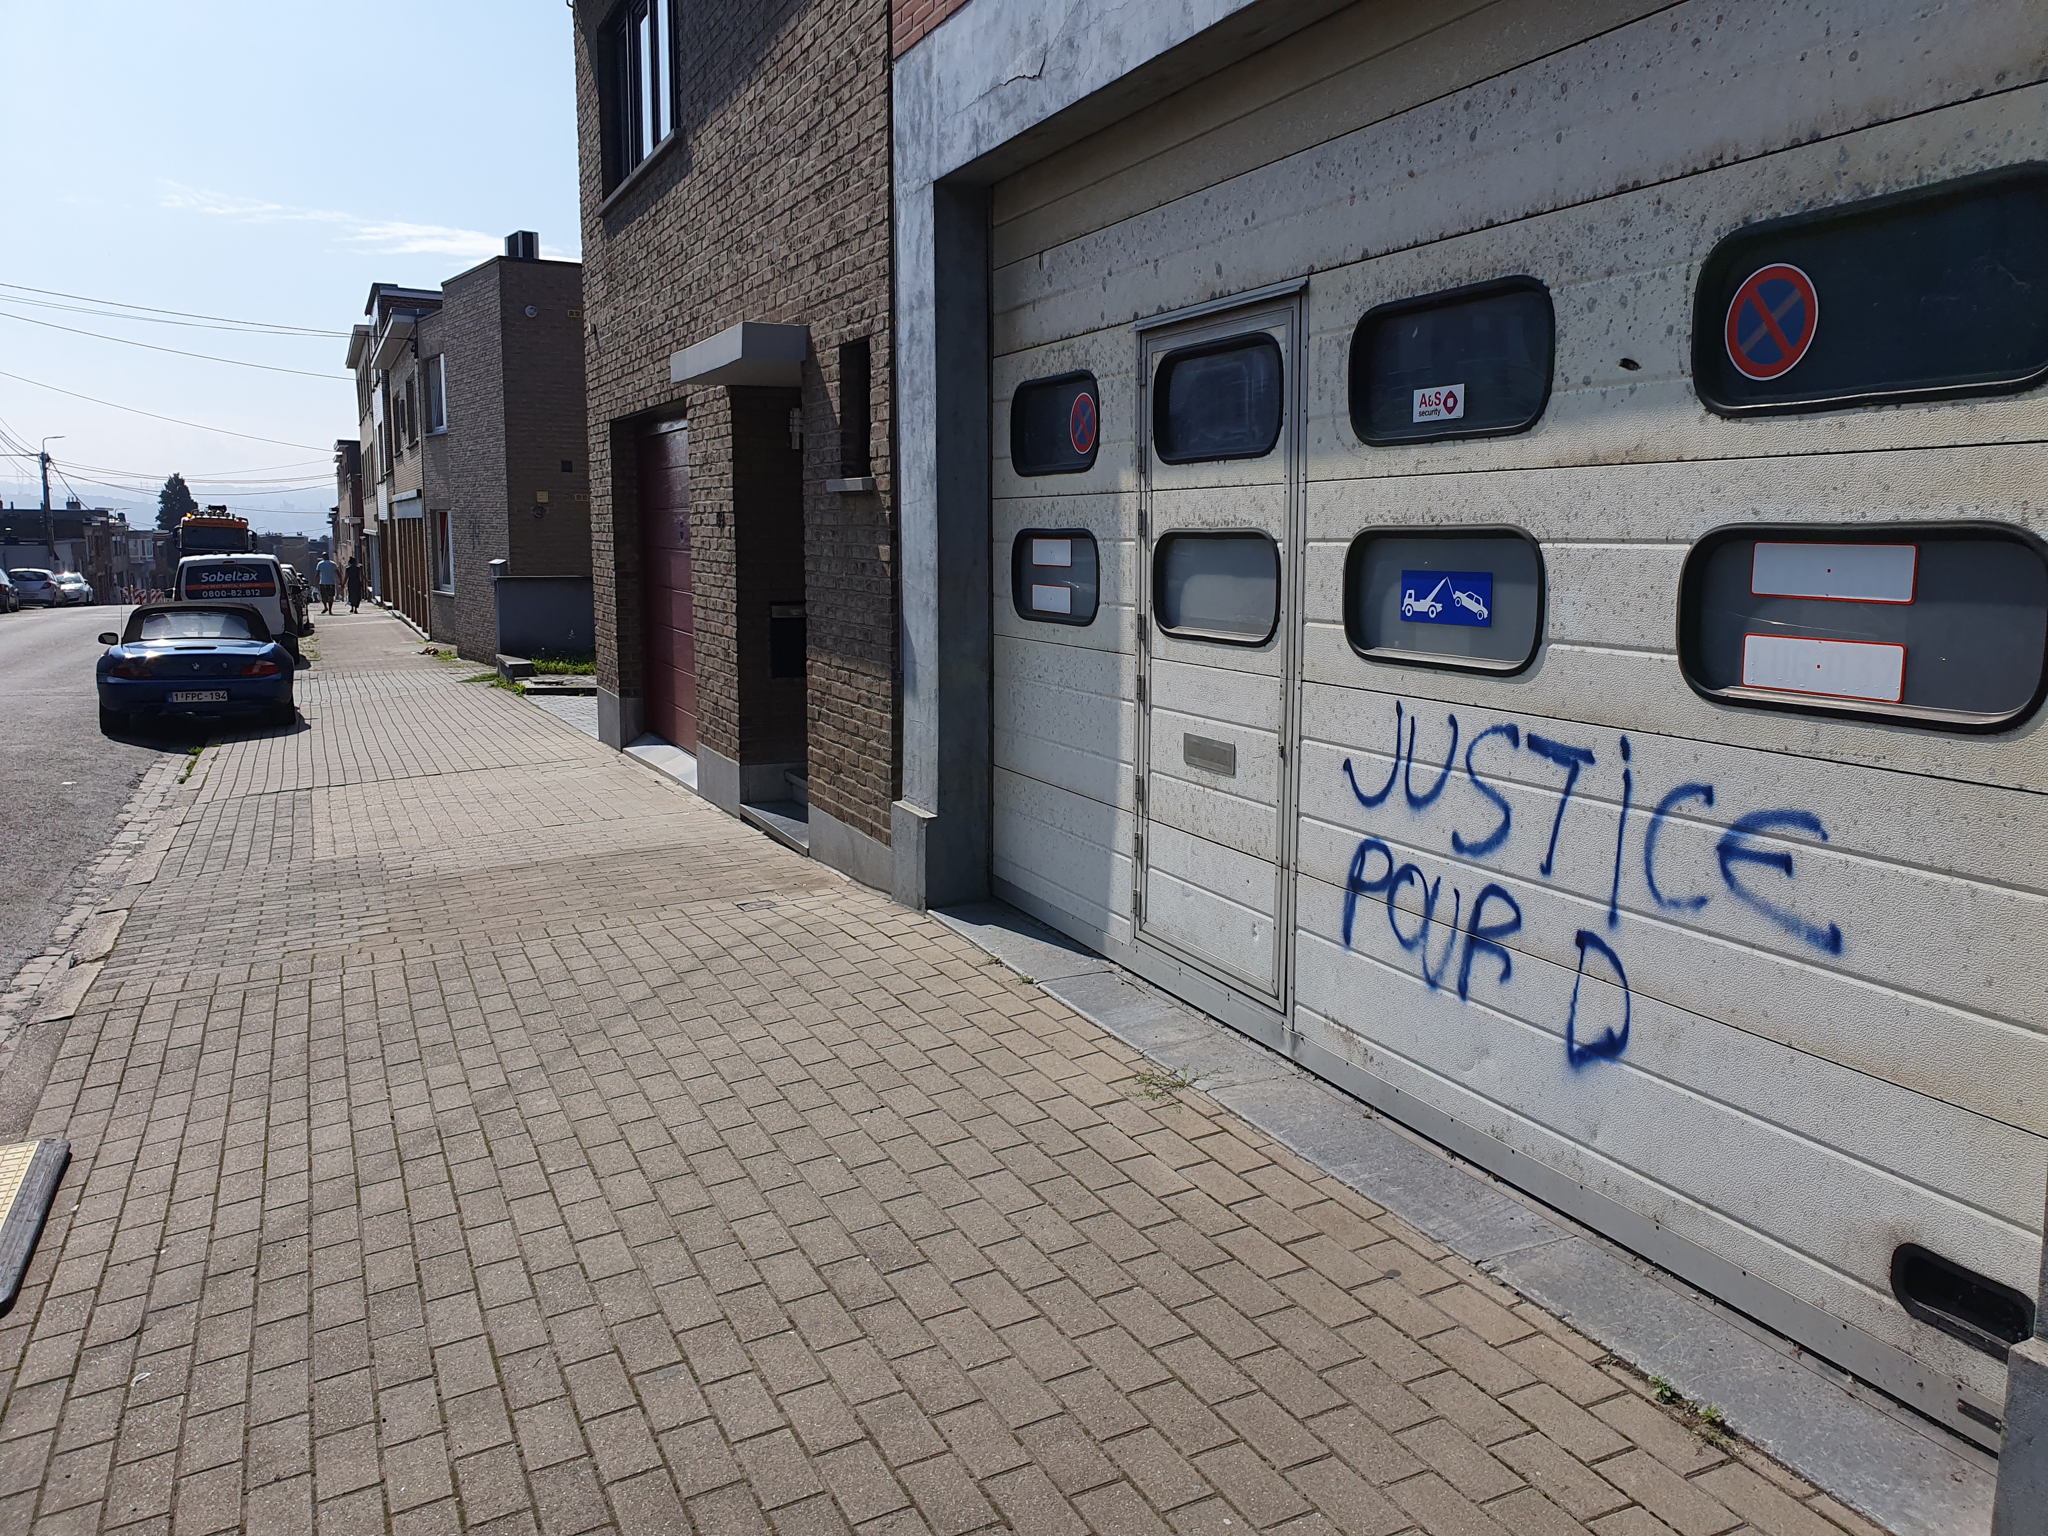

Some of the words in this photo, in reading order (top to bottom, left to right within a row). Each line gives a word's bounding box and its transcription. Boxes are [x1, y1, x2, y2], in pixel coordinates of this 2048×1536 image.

[1419, 391, 1442, 408] A&S
[1418, 408, 1441, 417] security
[201, 571, 258, 582] Sobeltax
[1341, 837, 1522, 1001] POUR
[1566, 929, 1631, 1072] D
